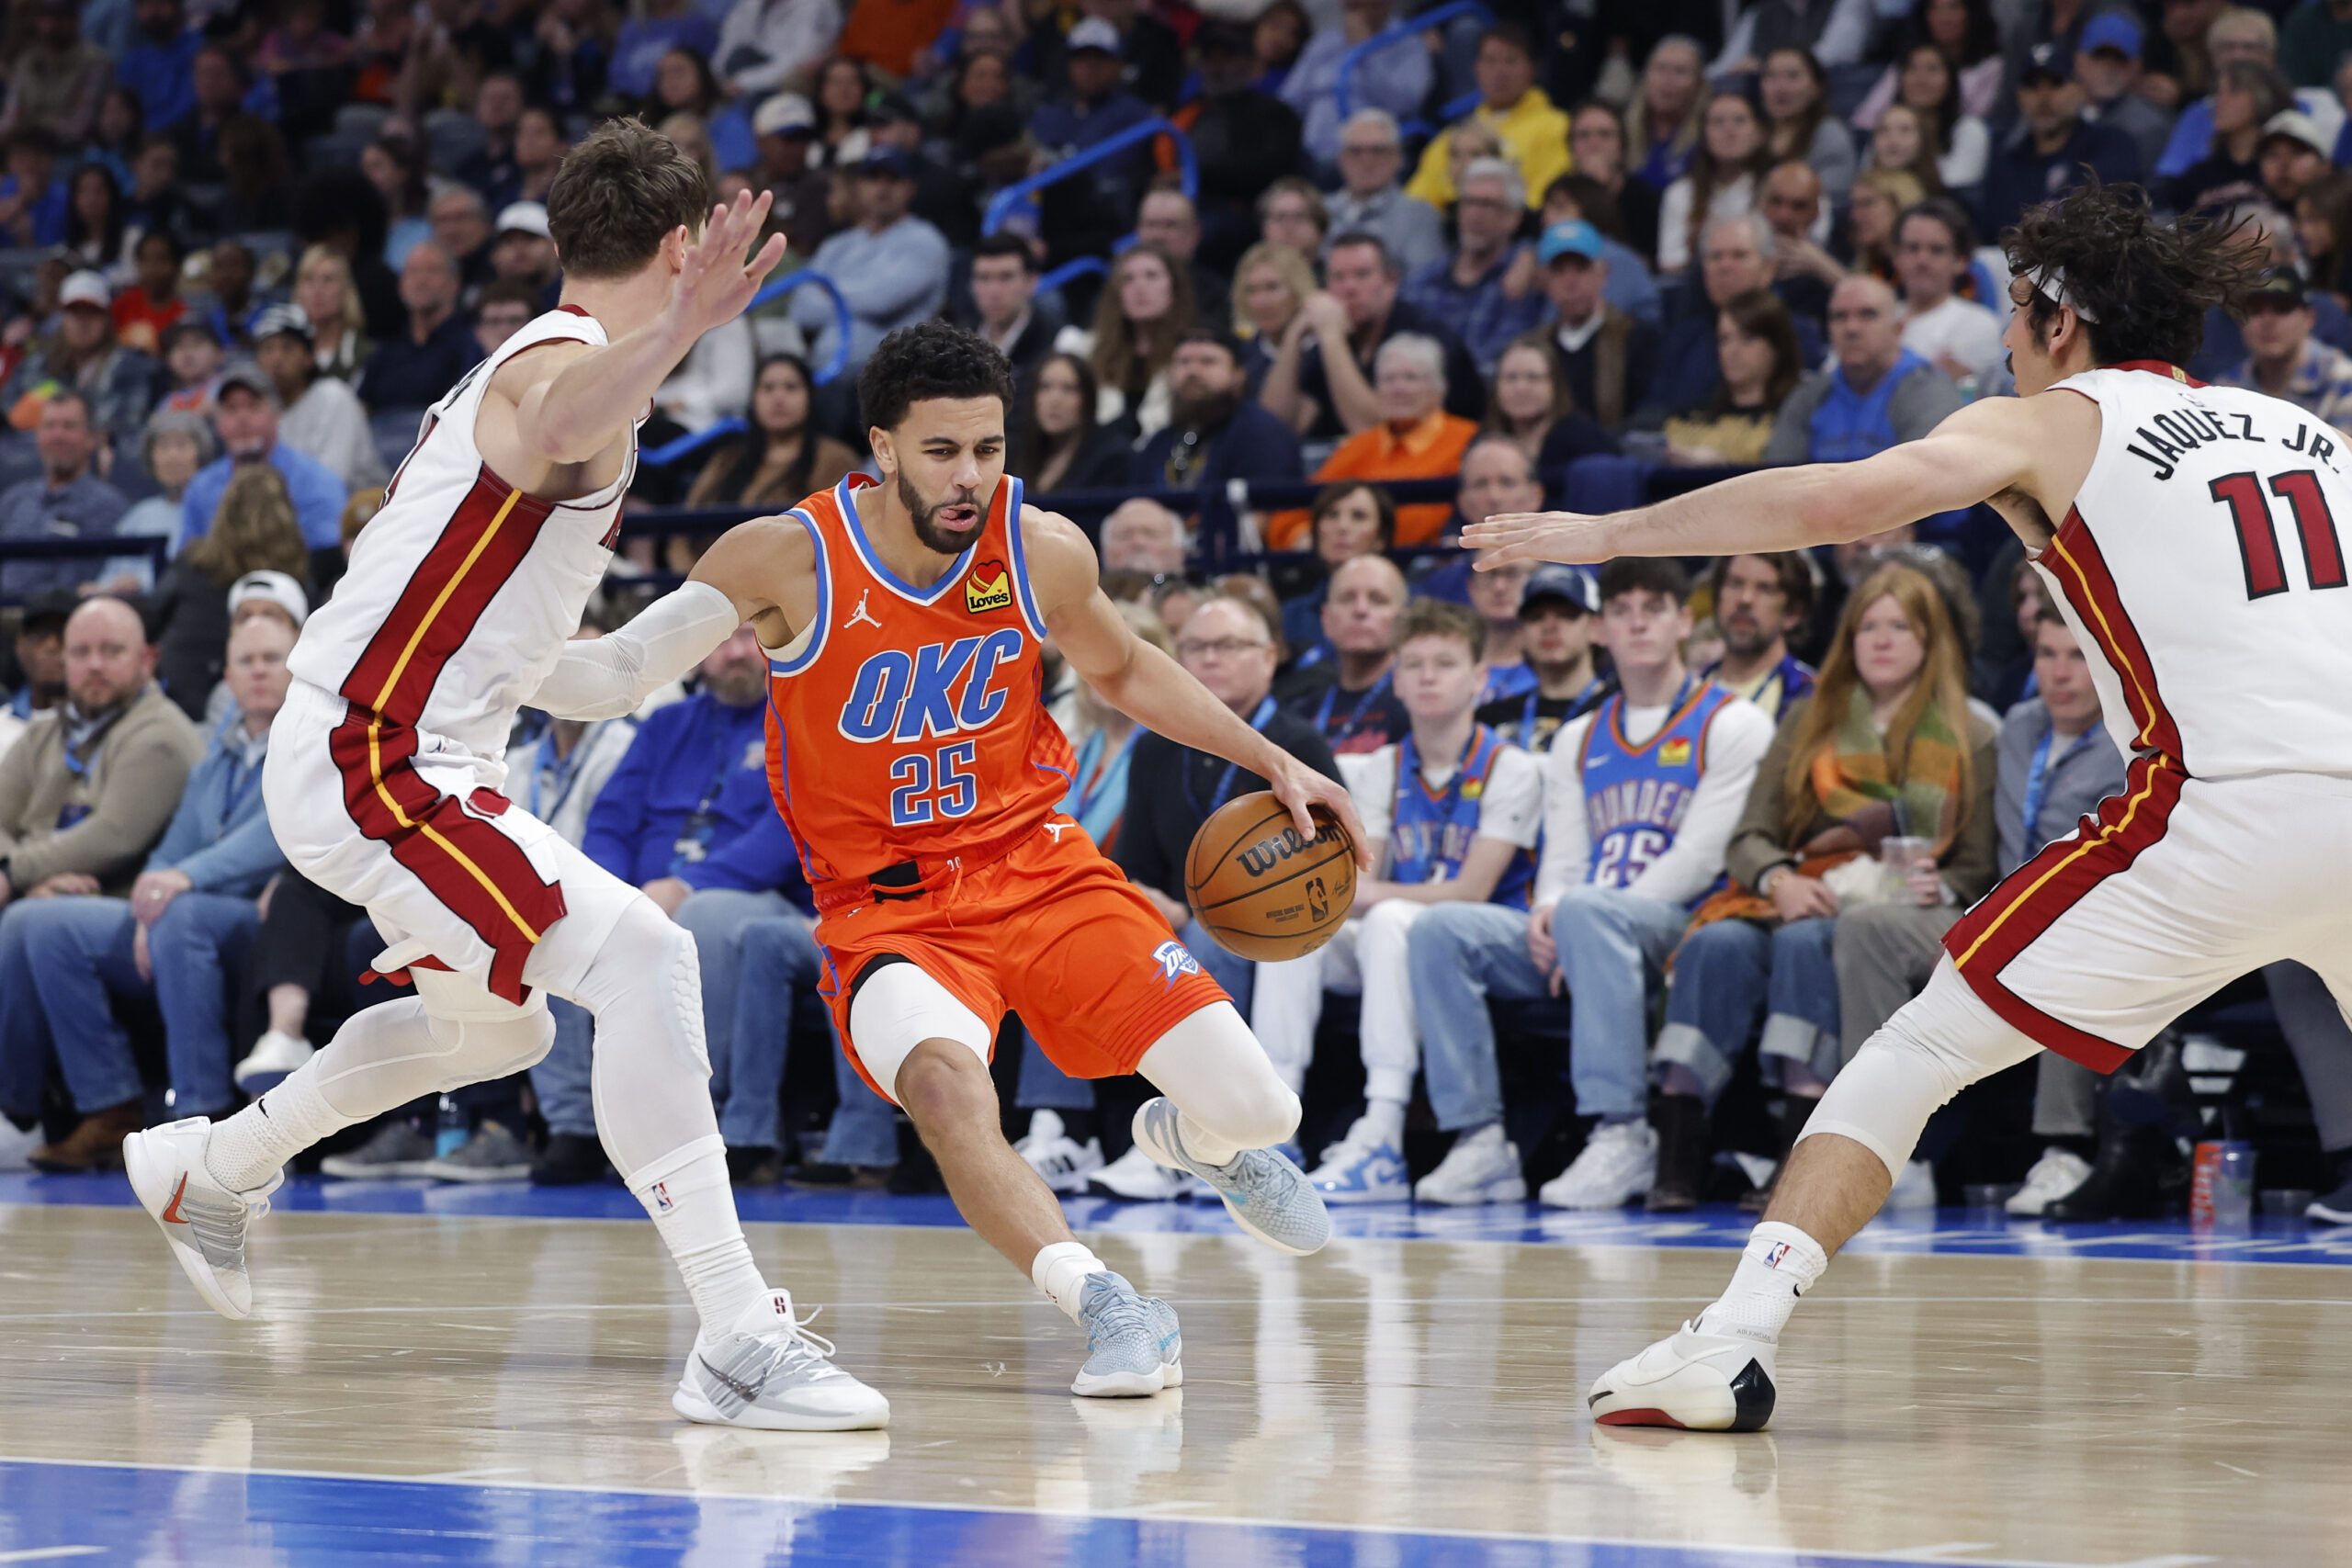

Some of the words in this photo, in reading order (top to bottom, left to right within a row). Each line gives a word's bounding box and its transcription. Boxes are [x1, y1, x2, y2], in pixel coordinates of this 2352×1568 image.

[2126, 409, 2266, 480] JAQUEZ
[2207, 469, 2348, 601] 11
[837, 627, 1023, 744] OKC
[889, 739, 978, 827] 25
